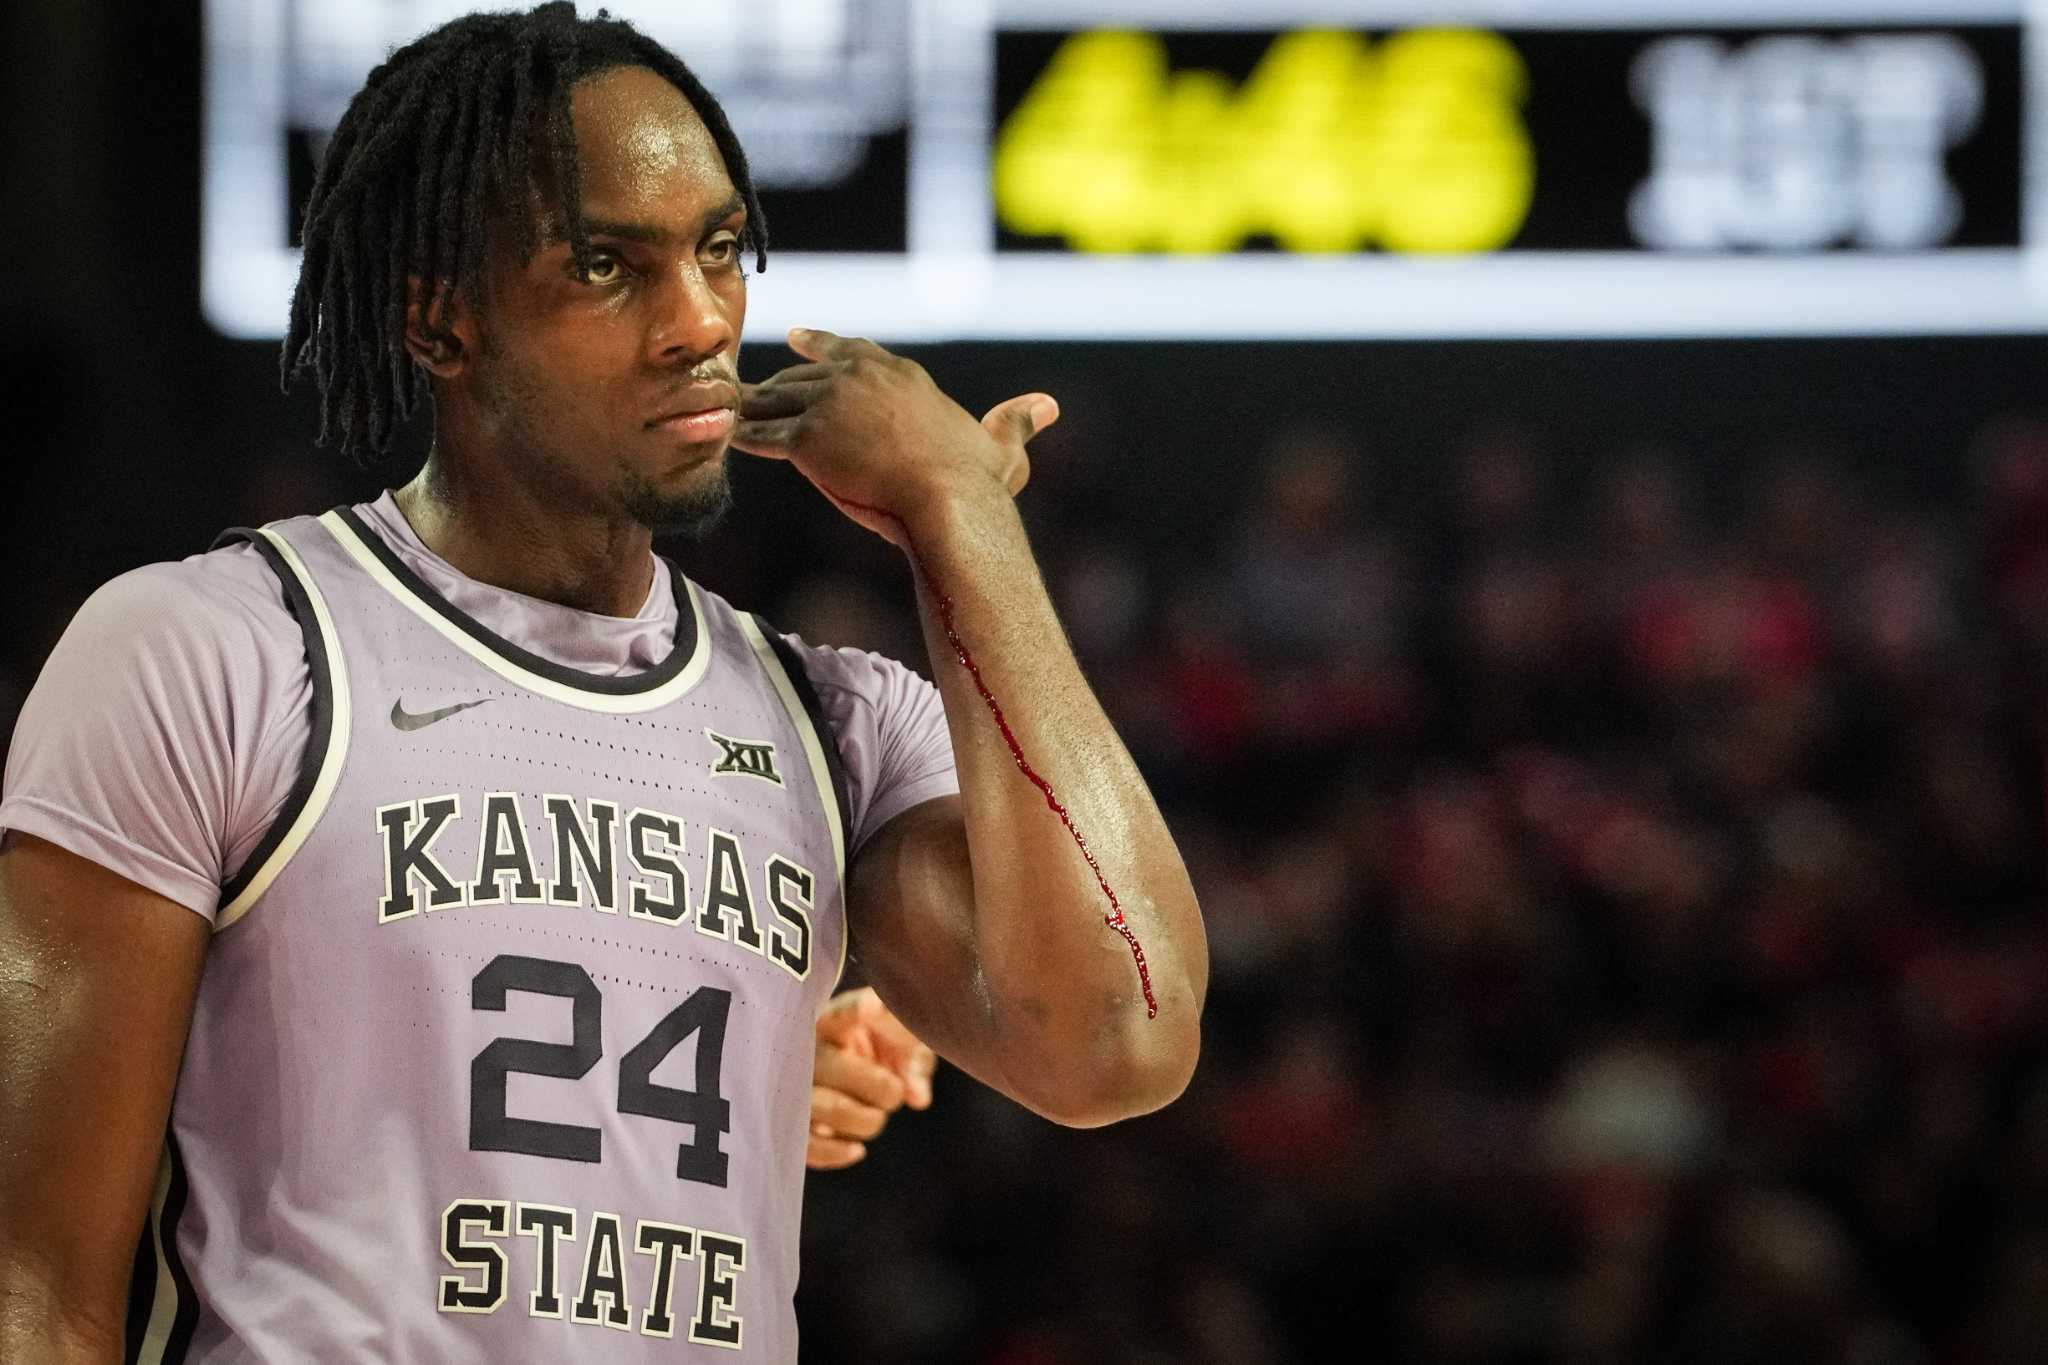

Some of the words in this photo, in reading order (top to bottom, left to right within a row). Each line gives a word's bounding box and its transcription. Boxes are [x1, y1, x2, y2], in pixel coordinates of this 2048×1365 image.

[1628, 34, 1984, 251] 1ST
[707, 730, 782, 787] XII
[376, 791, 815, 982] KANSAS
[469, 954, 732, 1188] 24
[437, 1198, 748, 1350] STATE
